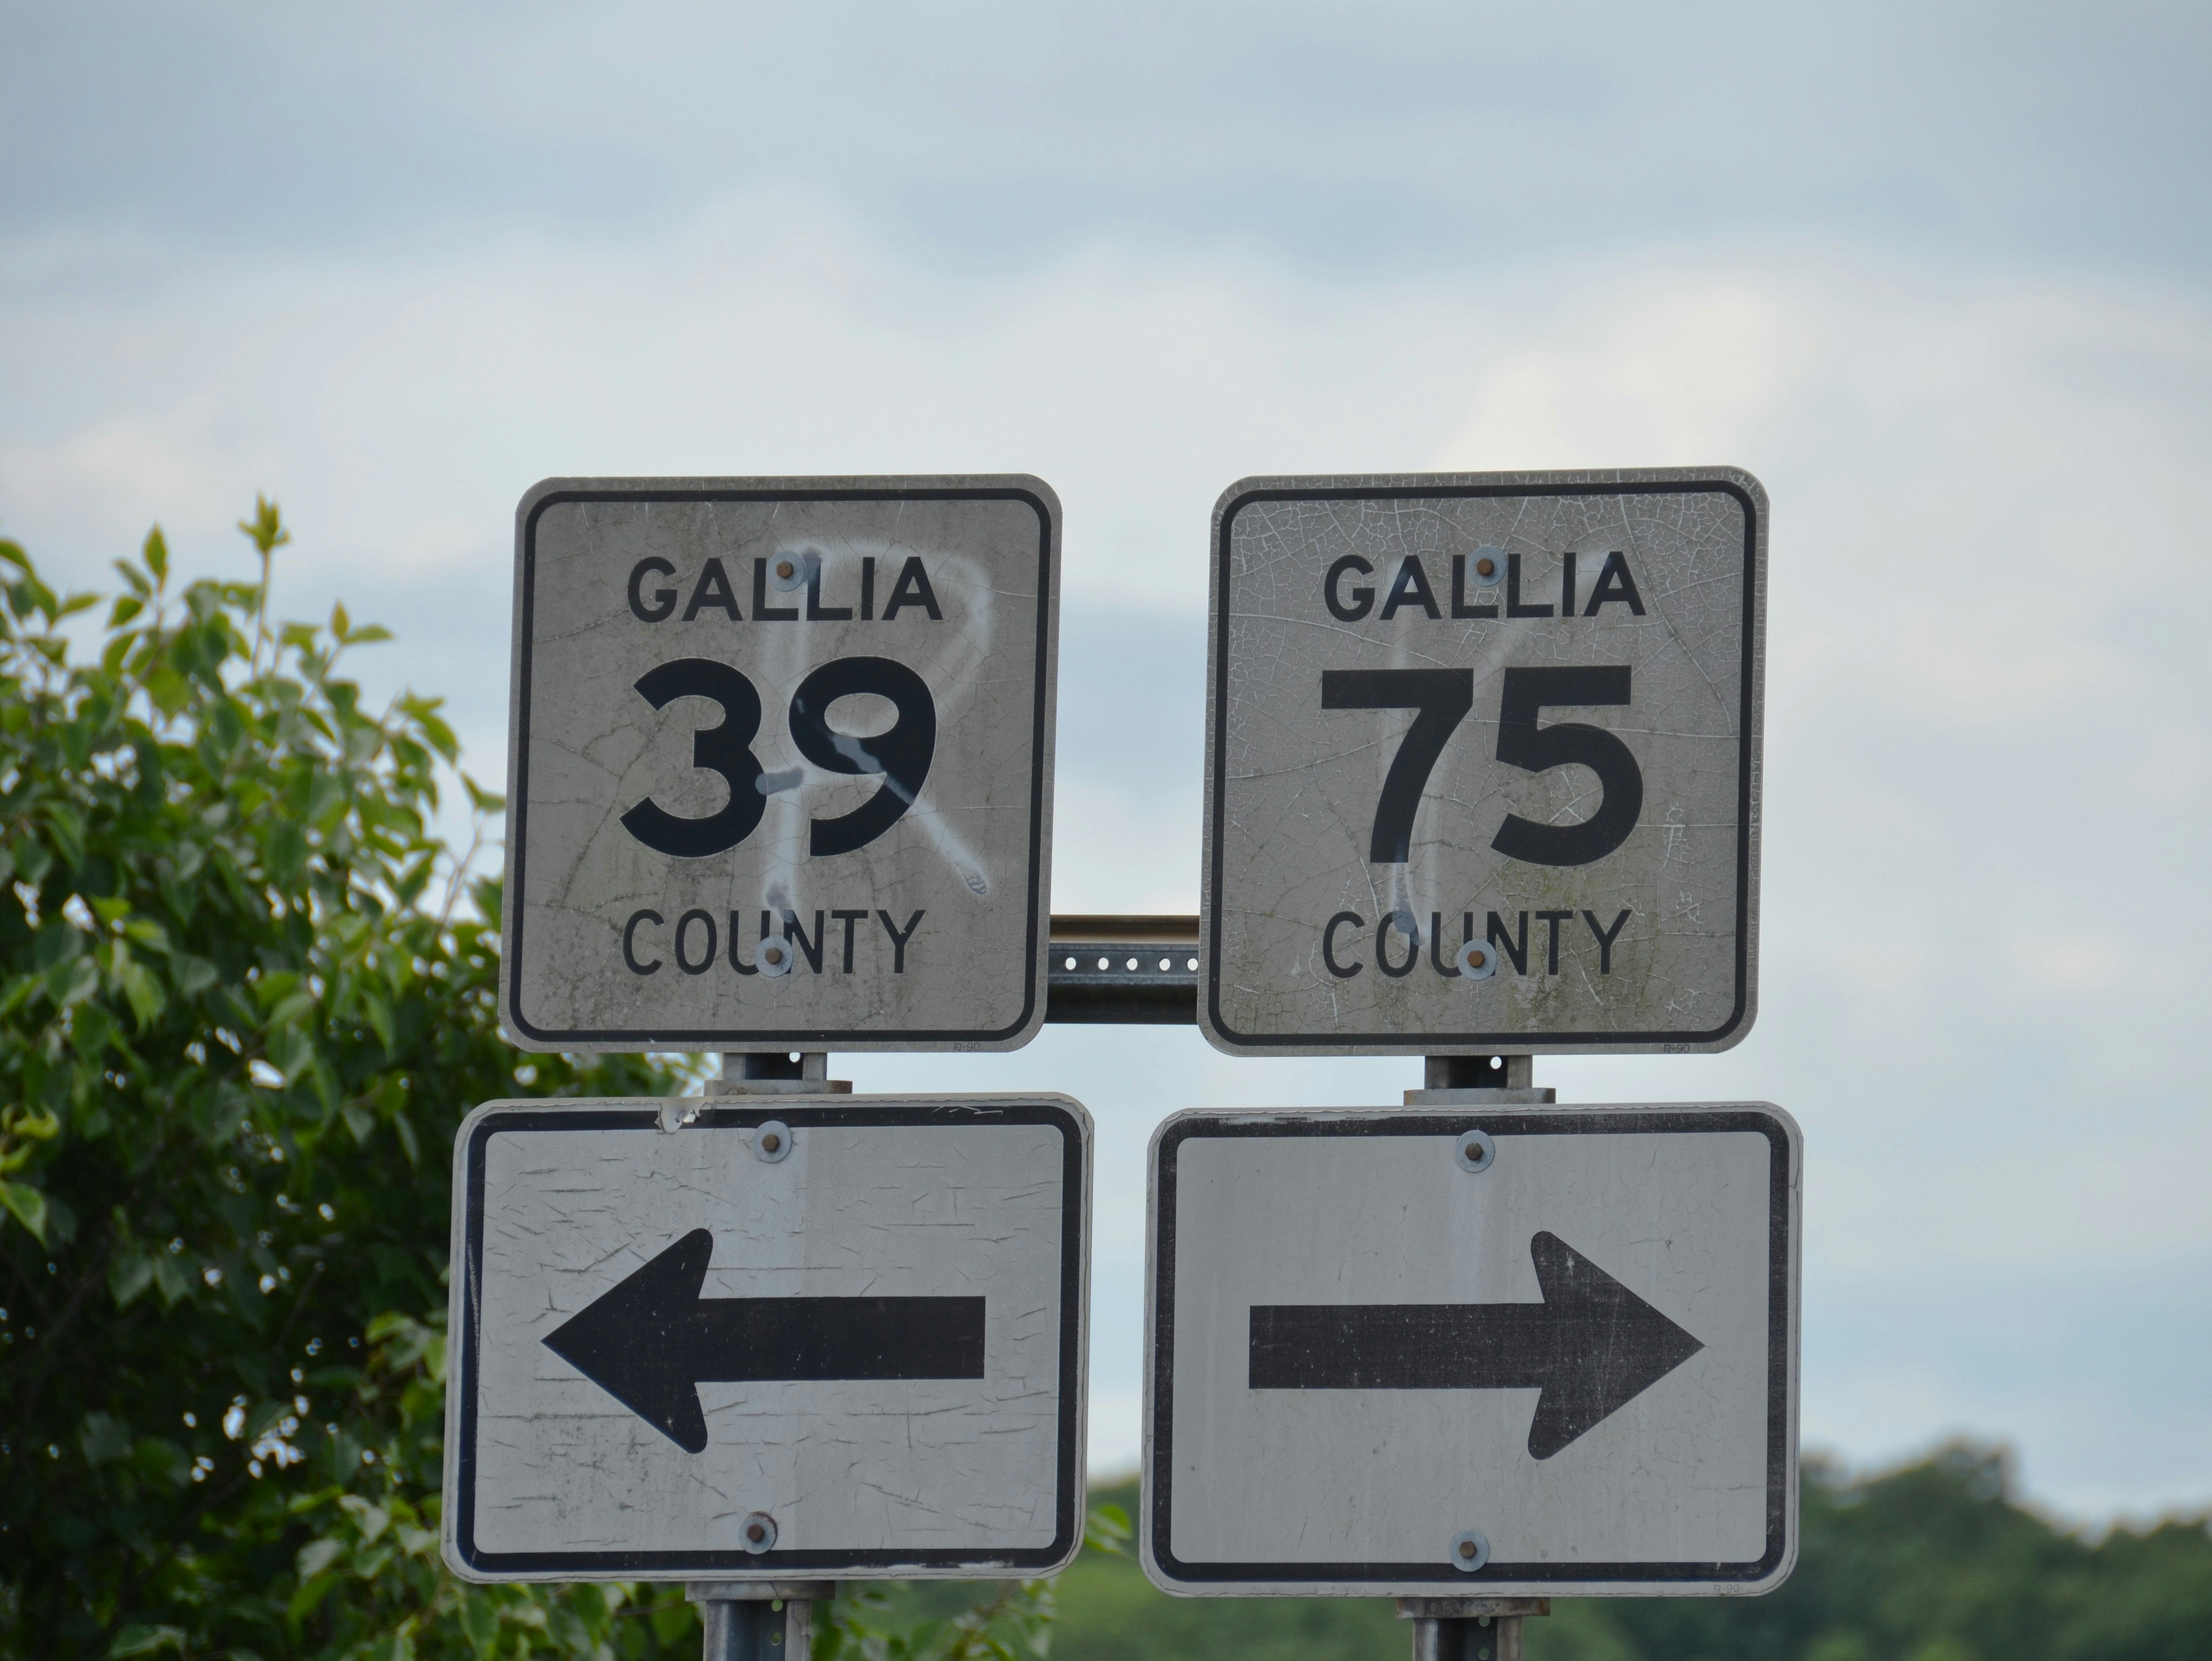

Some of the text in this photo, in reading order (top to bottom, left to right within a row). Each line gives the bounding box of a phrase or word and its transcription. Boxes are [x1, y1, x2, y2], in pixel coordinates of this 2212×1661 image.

[627, 556, 944, 623] GALLIA
[1324, 551, 1647, 622] GALLIA
[619, 656, 937, 858] 39
[1321, 665, 1643, 867] 75
[622, 909, 926, 976] COUNTY
[1323, 909, 1632, 979] COUNTY
